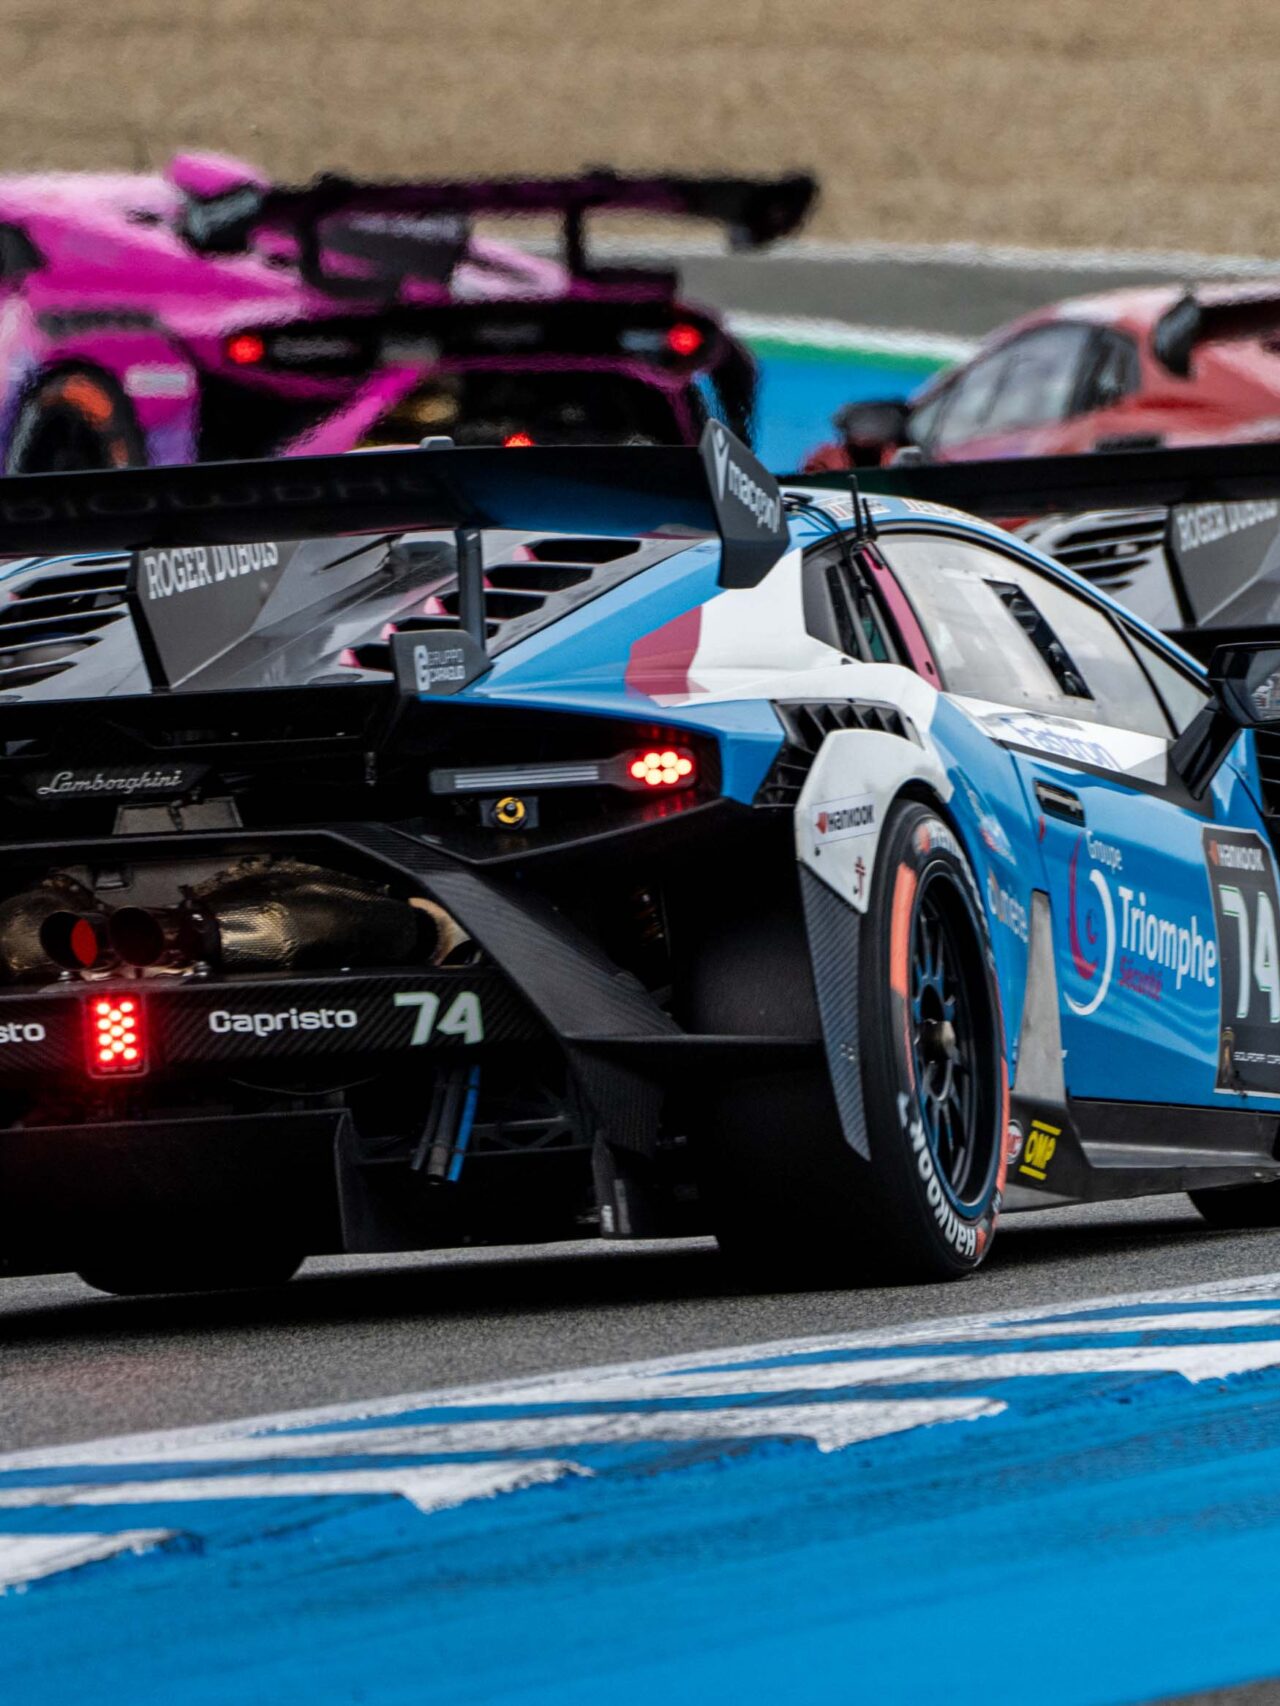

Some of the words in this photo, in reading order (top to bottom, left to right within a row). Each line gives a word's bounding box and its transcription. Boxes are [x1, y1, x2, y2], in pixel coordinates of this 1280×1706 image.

[144, 547, 213, 600] ROGER
[36, 770, 182, 795] Lamborghini
[1118, 885, 1217, 991] Triomphe
[208, 1008, 358, 1037] Capristo
[394, 991, 484, 1046] 74
